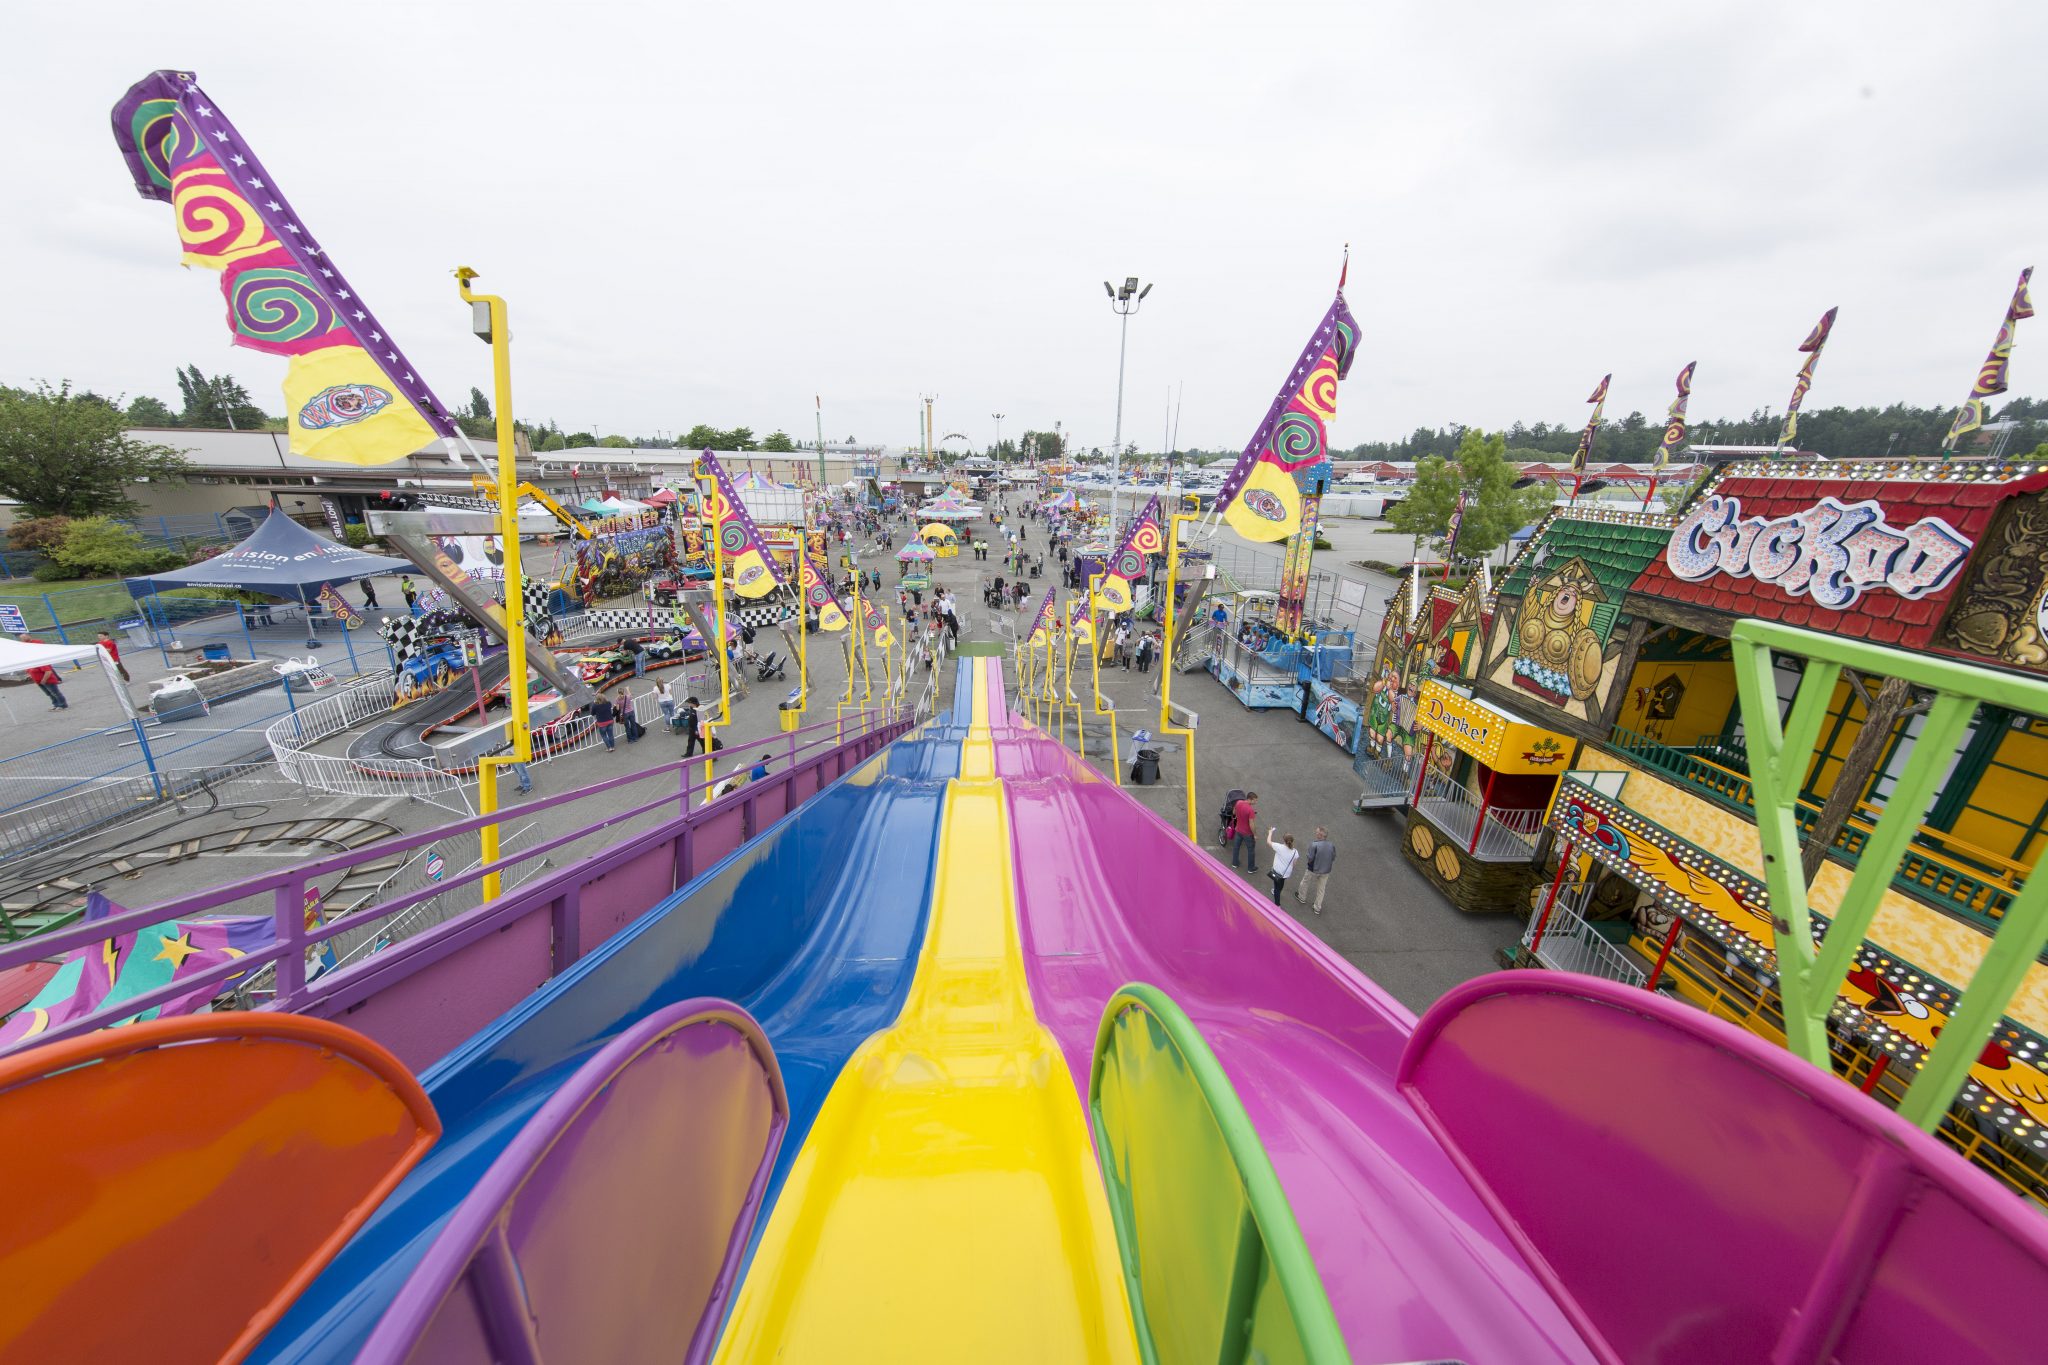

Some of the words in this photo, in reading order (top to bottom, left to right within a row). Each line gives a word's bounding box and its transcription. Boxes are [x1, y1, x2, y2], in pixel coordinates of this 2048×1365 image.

[302, 386, 385, 427] WCA
[326, 502, 338, 520] HOT
[591, 510, 660, 538] MONSTER
[331, 520, 344, 539] TUBS
[1427, 698, 1488, 745] Danke!
